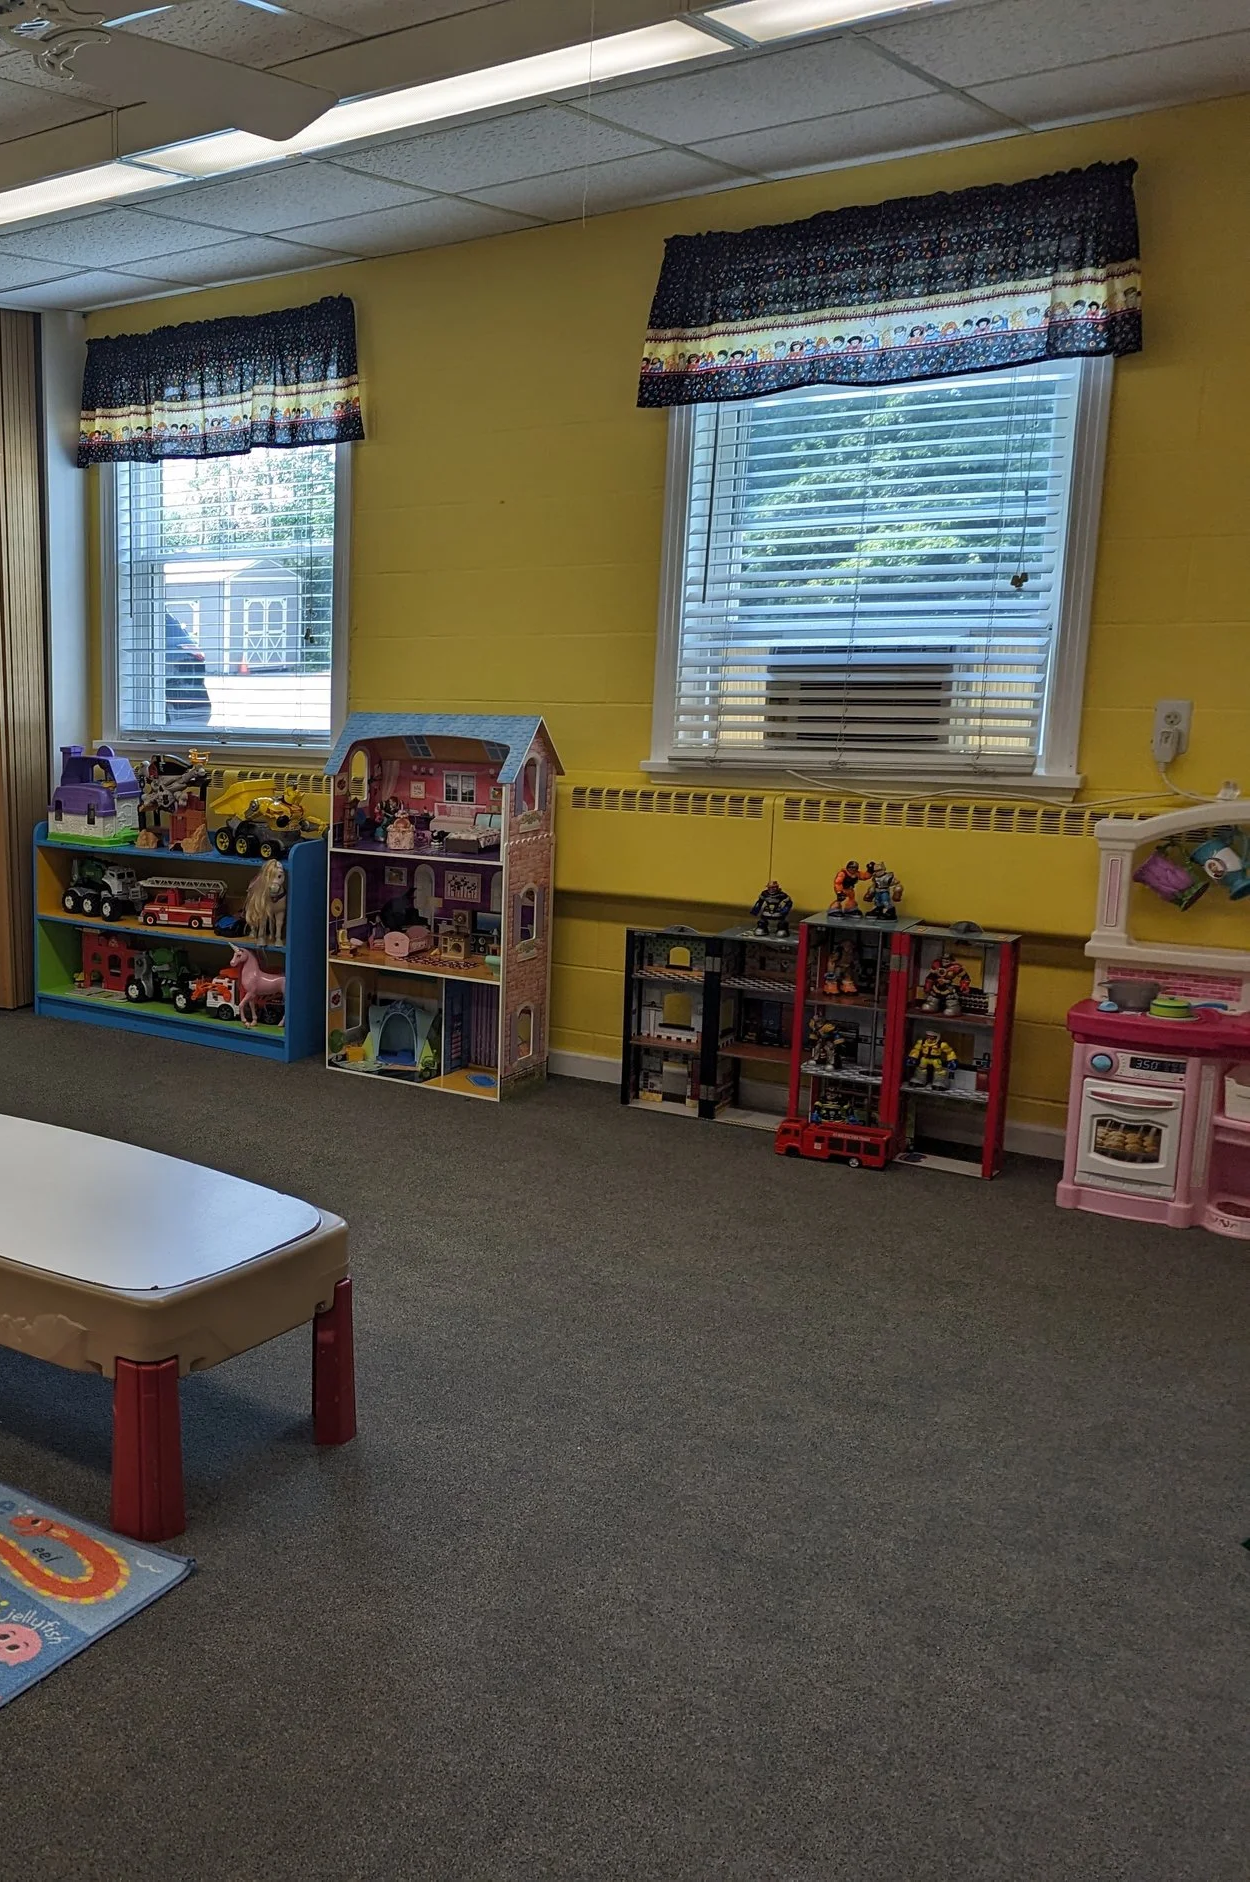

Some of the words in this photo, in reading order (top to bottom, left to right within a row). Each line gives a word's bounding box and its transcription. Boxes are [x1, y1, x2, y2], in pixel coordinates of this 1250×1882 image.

[1135, 1059, 1159, 1071] 350
[31, 1545, 63, 1564] eel
[0, 1608, 71, 1645] jellyfish
